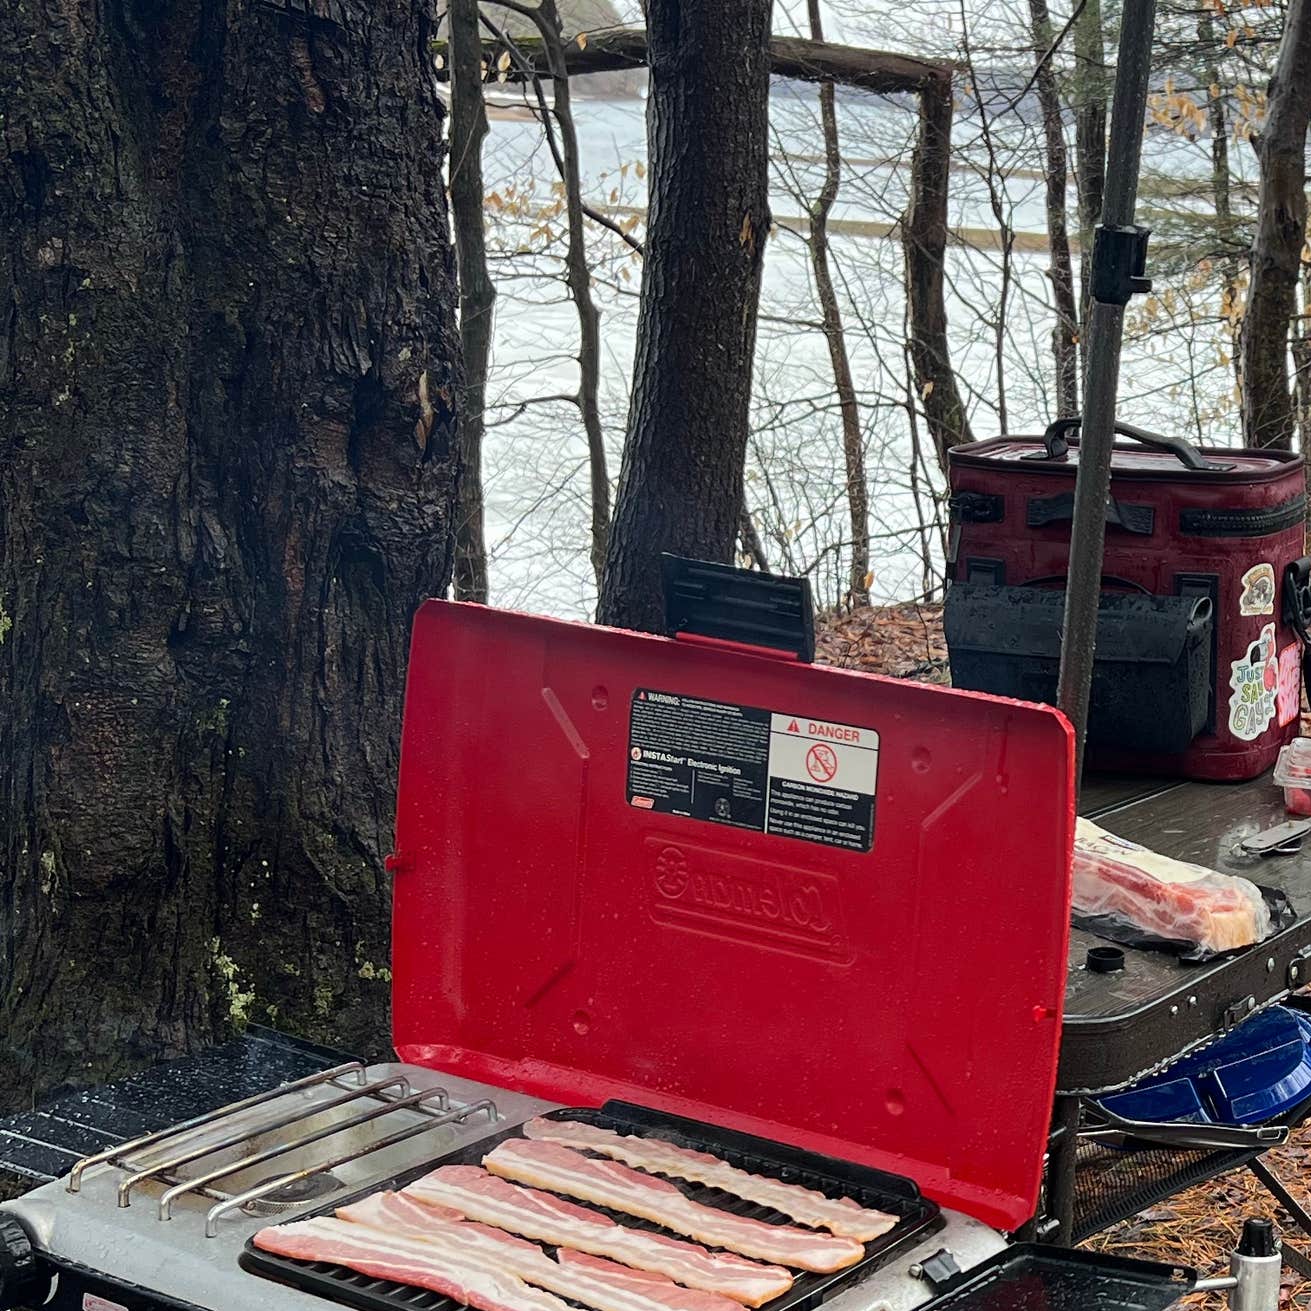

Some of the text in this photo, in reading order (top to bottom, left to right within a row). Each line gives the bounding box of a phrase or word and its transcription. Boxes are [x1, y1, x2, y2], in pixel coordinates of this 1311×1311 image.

[1241, 681, 1264, 704] SAY
[1233, 698, 1264, 735] GAY
[808, 723, 860, 743] DANGER
[687, 758, 717, 771] Electronic
[718, 764, 741, 775] Ignition
